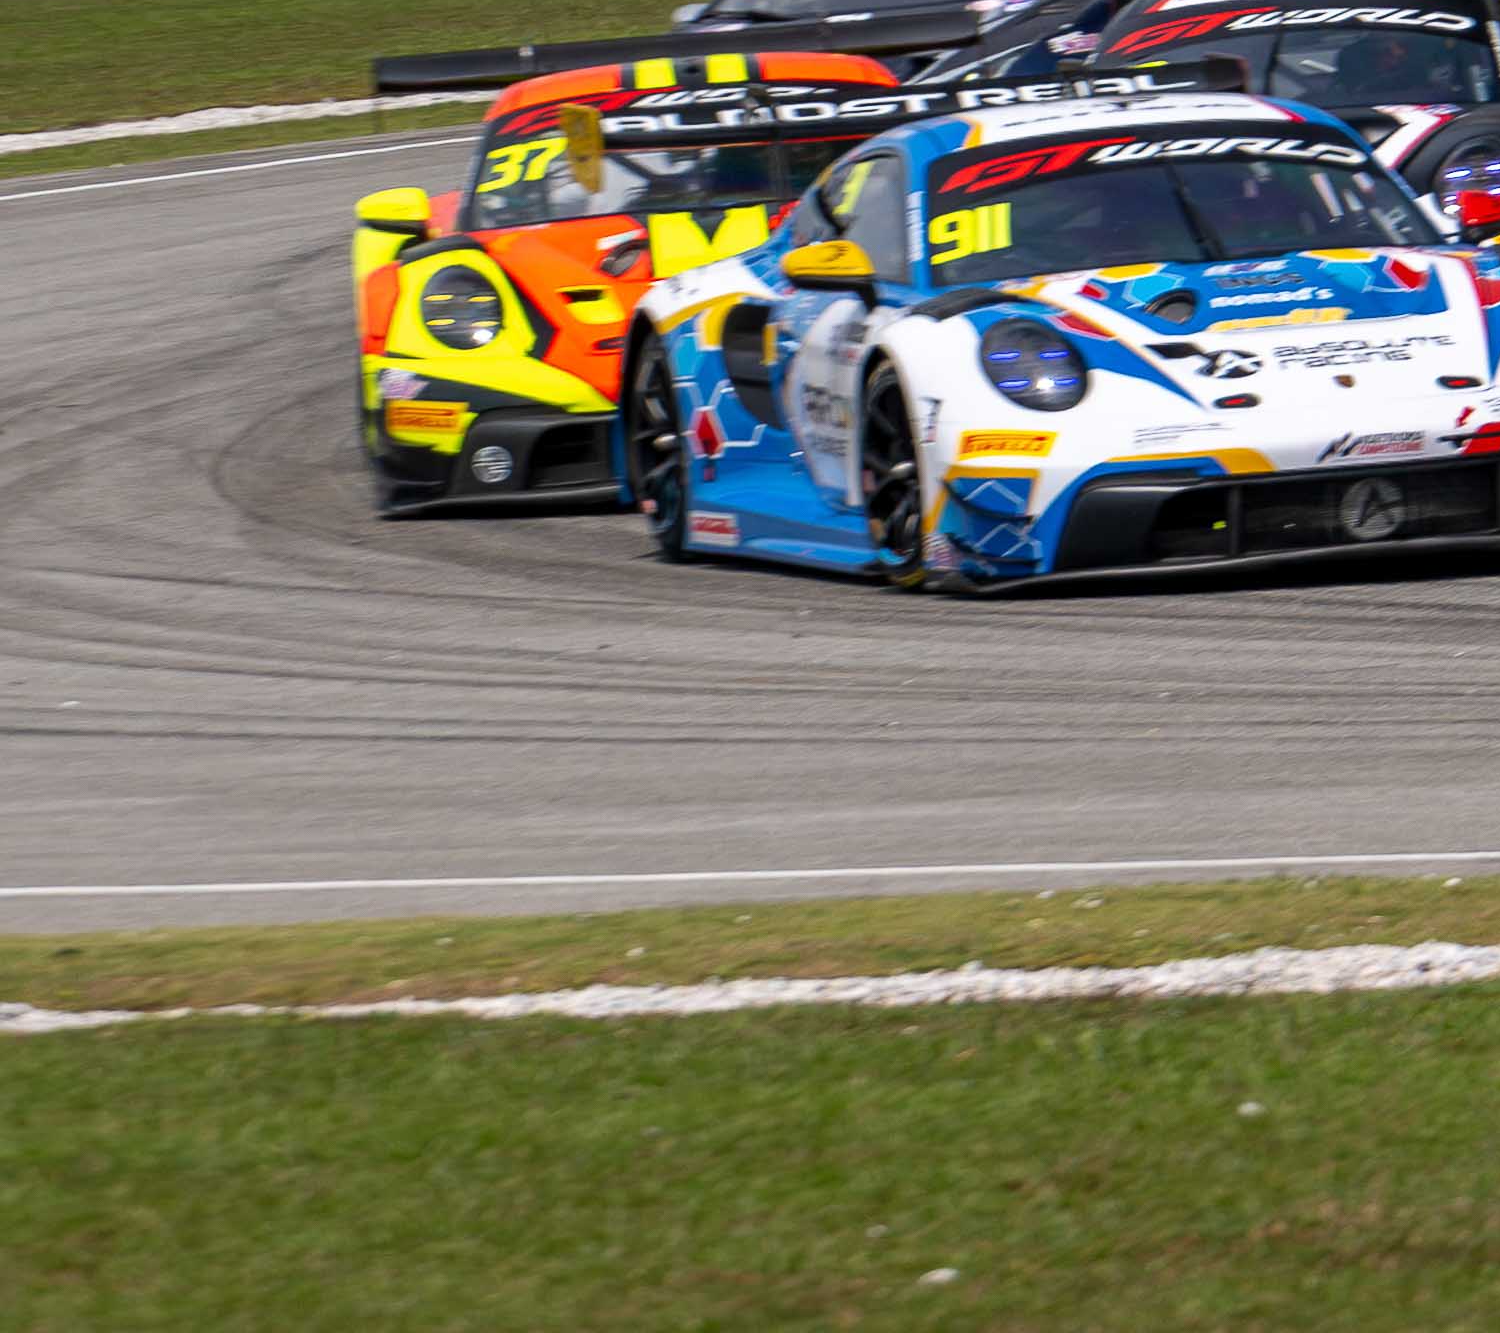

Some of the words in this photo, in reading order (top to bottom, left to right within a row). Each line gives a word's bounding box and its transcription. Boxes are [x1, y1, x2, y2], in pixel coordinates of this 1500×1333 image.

[1224, 7, 1478, 32] WORLD
[1086, 137, 1369, 165] WORLD
[474, 137, 569, 194] 37
[928, 202, 1012, 266] 911
[960, 435, 1049, 457] PIRELLI
